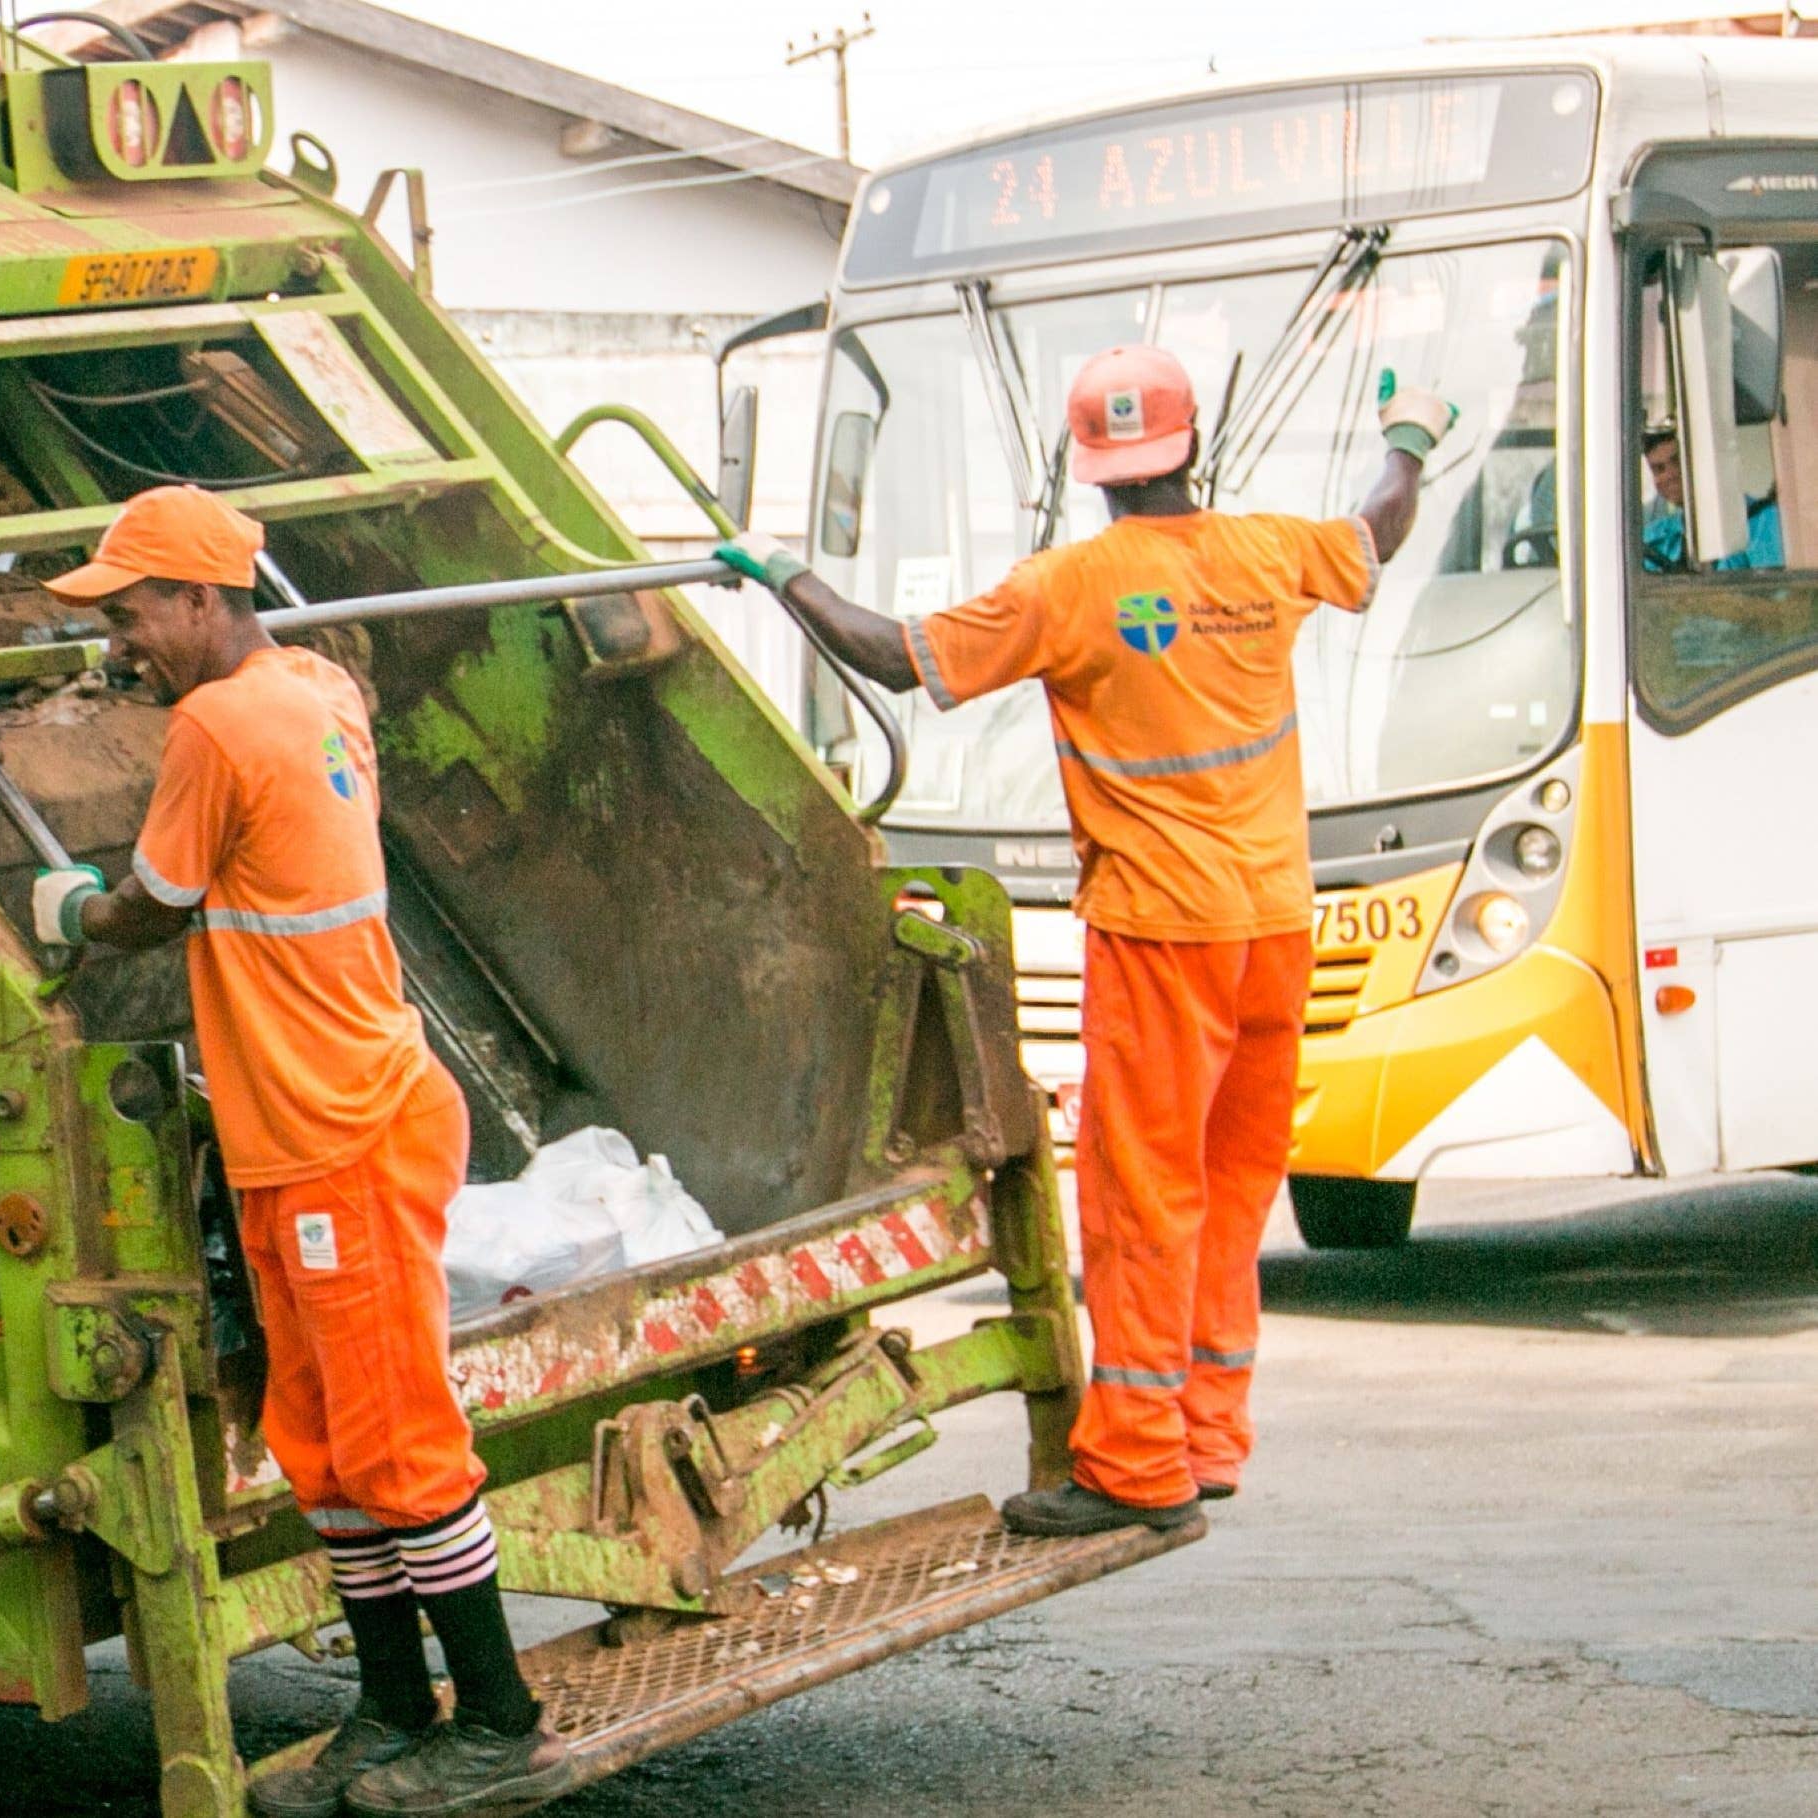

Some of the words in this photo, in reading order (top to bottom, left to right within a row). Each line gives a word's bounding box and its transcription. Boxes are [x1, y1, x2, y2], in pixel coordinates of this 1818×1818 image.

[991, 154, 1058, 226] 24
[1099, 93, 1466, 209] AZULVILLE
[1191, 615, 1277, 635] Ambiental
[1314, 896, 1423, 946] 7503
